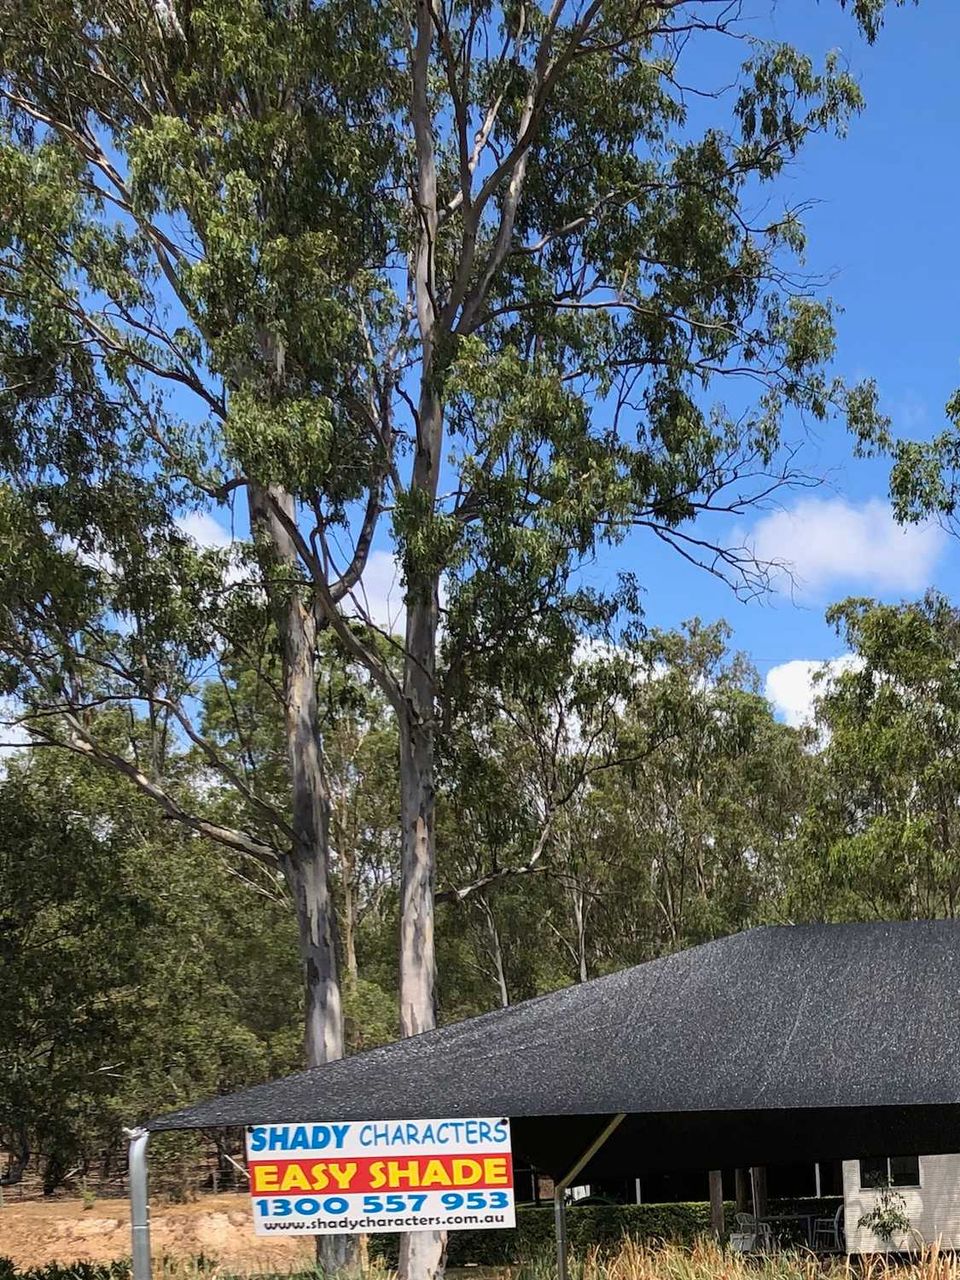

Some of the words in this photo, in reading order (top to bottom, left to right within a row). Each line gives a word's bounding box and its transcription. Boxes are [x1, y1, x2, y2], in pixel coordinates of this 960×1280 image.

[250, 1125, 351, 1151] SHADY
[359, 1121, 507, 1146] CHARACTERS
[254, 1162, 358, 1192] EASY
[369, 1158, 508, 1189] SHADE
[256, 1197, 349, 1216] 1300
[363, 1194, 427, 1213] 557
[441, 1192, 509, 1210] 953
[264, 1213, 505, 1231] www.shadycharacters.com.au
